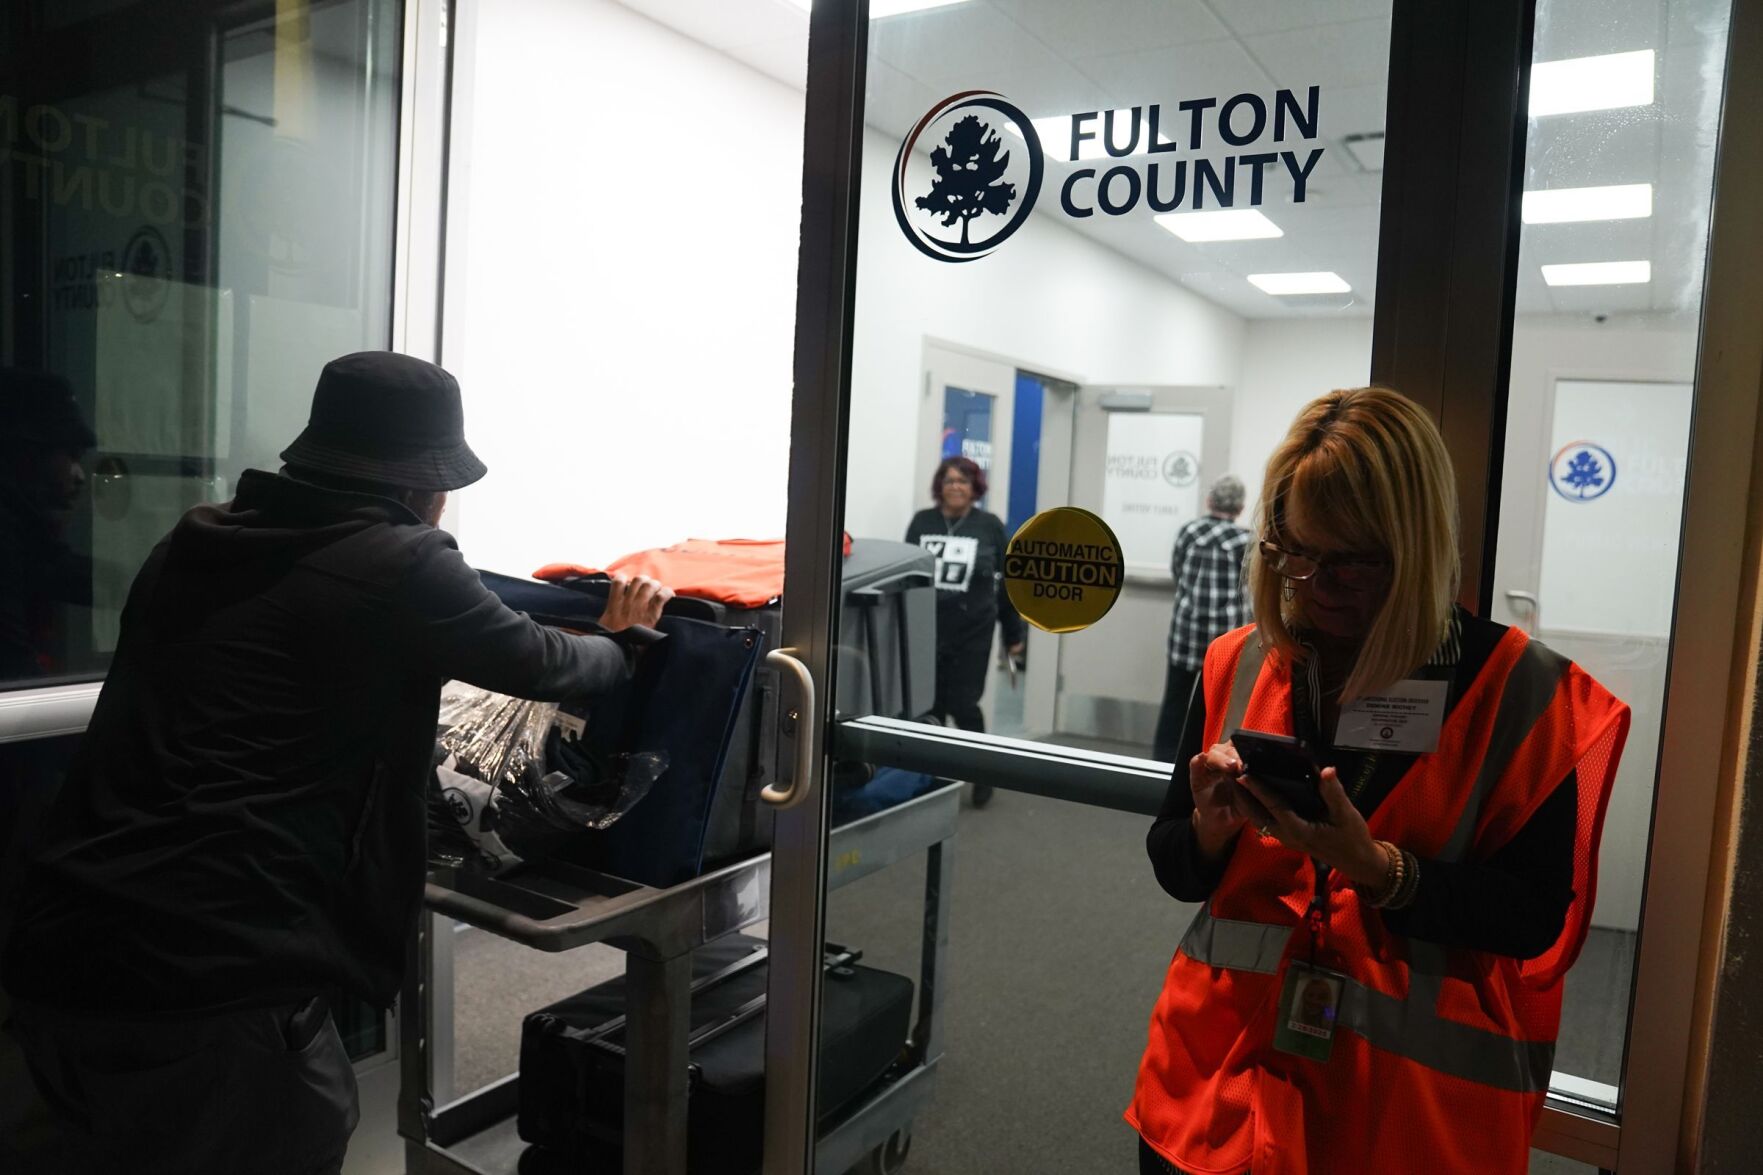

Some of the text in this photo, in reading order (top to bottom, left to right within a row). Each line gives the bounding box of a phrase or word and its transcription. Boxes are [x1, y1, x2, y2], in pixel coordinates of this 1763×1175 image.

[1069, 85, 1320, 162] FULTON
[1060, 148, 1326, 218] COUNTY
[1011, 540, 1113, 561] AUTOMATIC
[1006, 557, 1117, 586] CAUTION
[1033, 582, 1084, 602] DOOR
